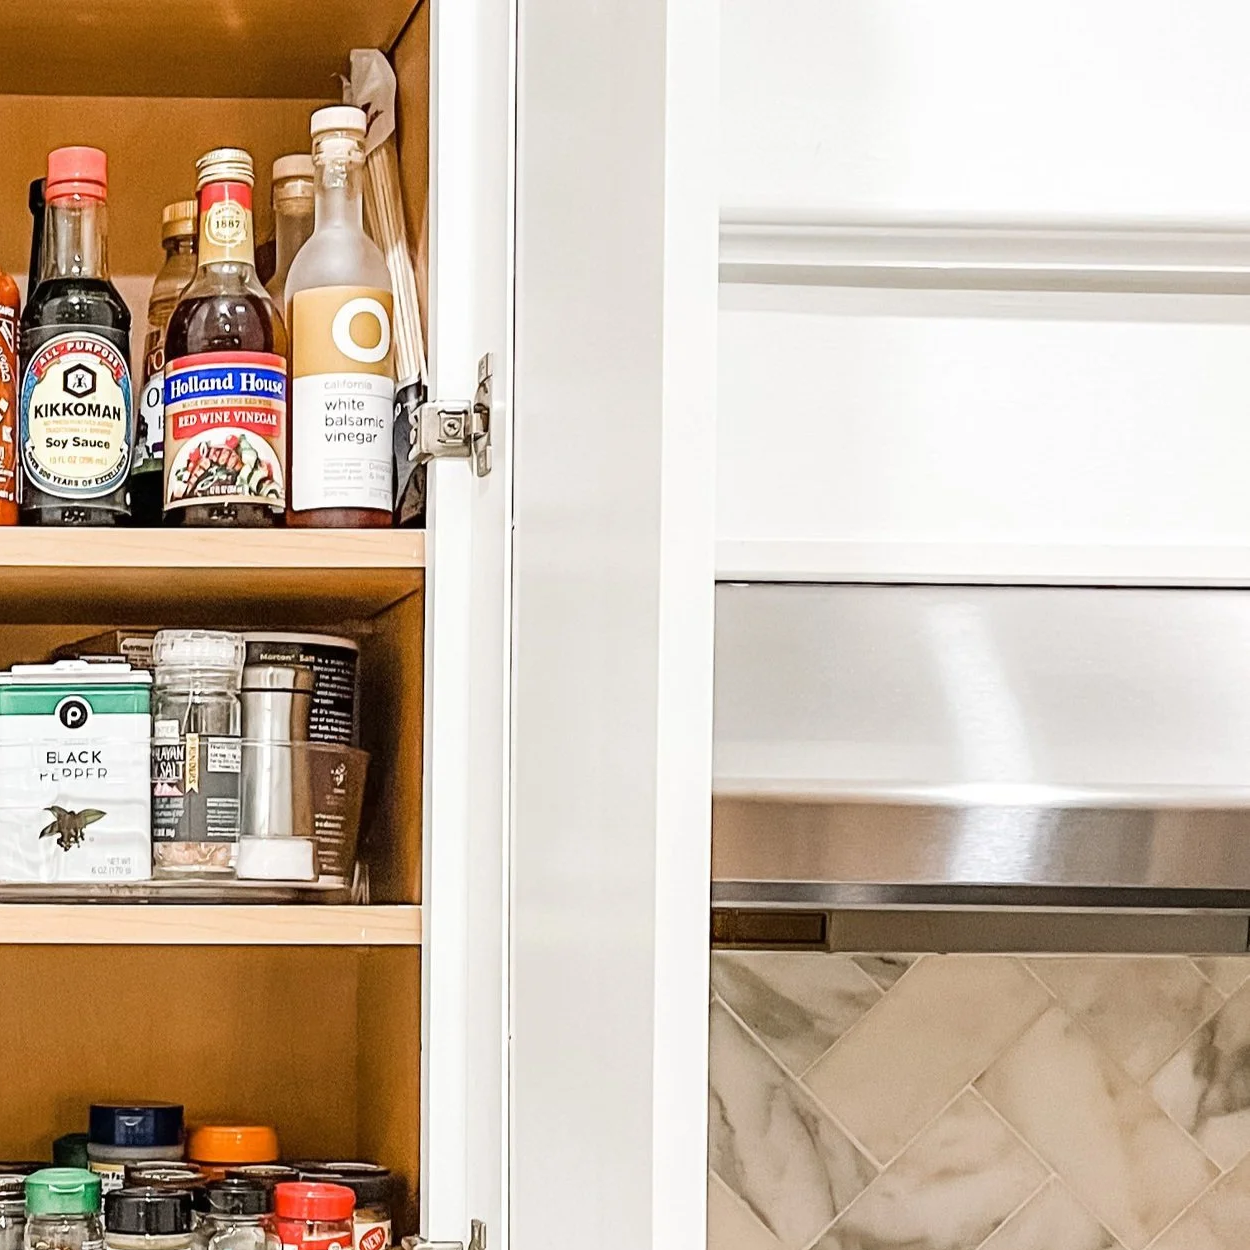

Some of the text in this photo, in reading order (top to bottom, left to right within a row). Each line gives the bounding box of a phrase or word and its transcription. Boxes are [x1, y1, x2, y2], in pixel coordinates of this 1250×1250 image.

[216, 220, 240, 229] 1887
[170, 372, 234, 399] Holland
[240, 372, 283, 395] House
[324, 379, 373, 391] california
[34, 402, 121, 421] KIKKOMAN
[324, 398, 365, 411] white
[178, 410, 278, 429] RED WINE VINEGAR
[324, 413, 386, 430] balsamic
[45, 437, 111, 450] Soy Sauce
[324, 430, 379, 445] vinegar
[52, 475, 79, 488] YEARS
[82, 479, 93, 488] OF
[46, 750, 103, 764] BLACK
[160, 761, 185, 780] SALT
